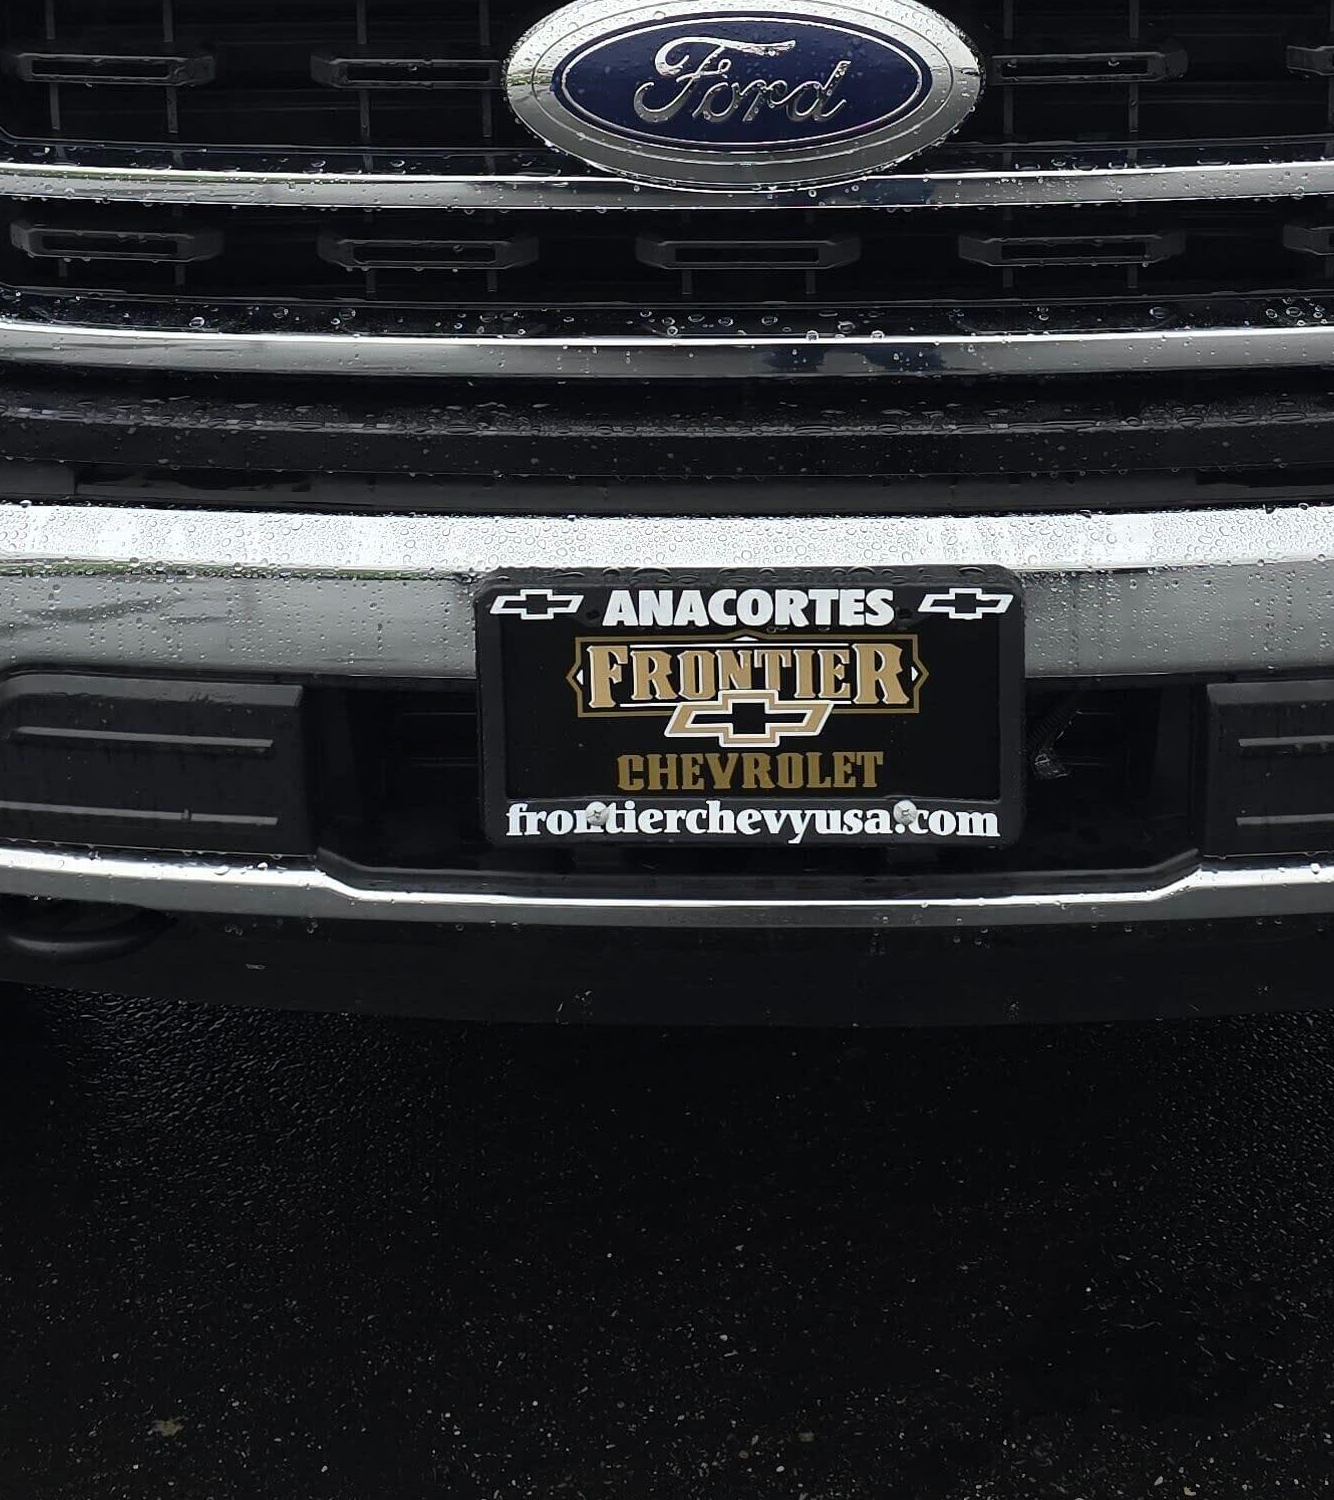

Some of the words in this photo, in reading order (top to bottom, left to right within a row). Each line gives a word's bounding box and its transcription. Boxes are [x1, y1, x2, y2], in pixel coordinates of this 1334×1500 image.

[633, 36, 851, 123] Ford
[602, 588, 895, 628] ANACORTES
[585, 642, 910, 708] FRONTIER
[616, 751, 884, 791] CHEVROLET
